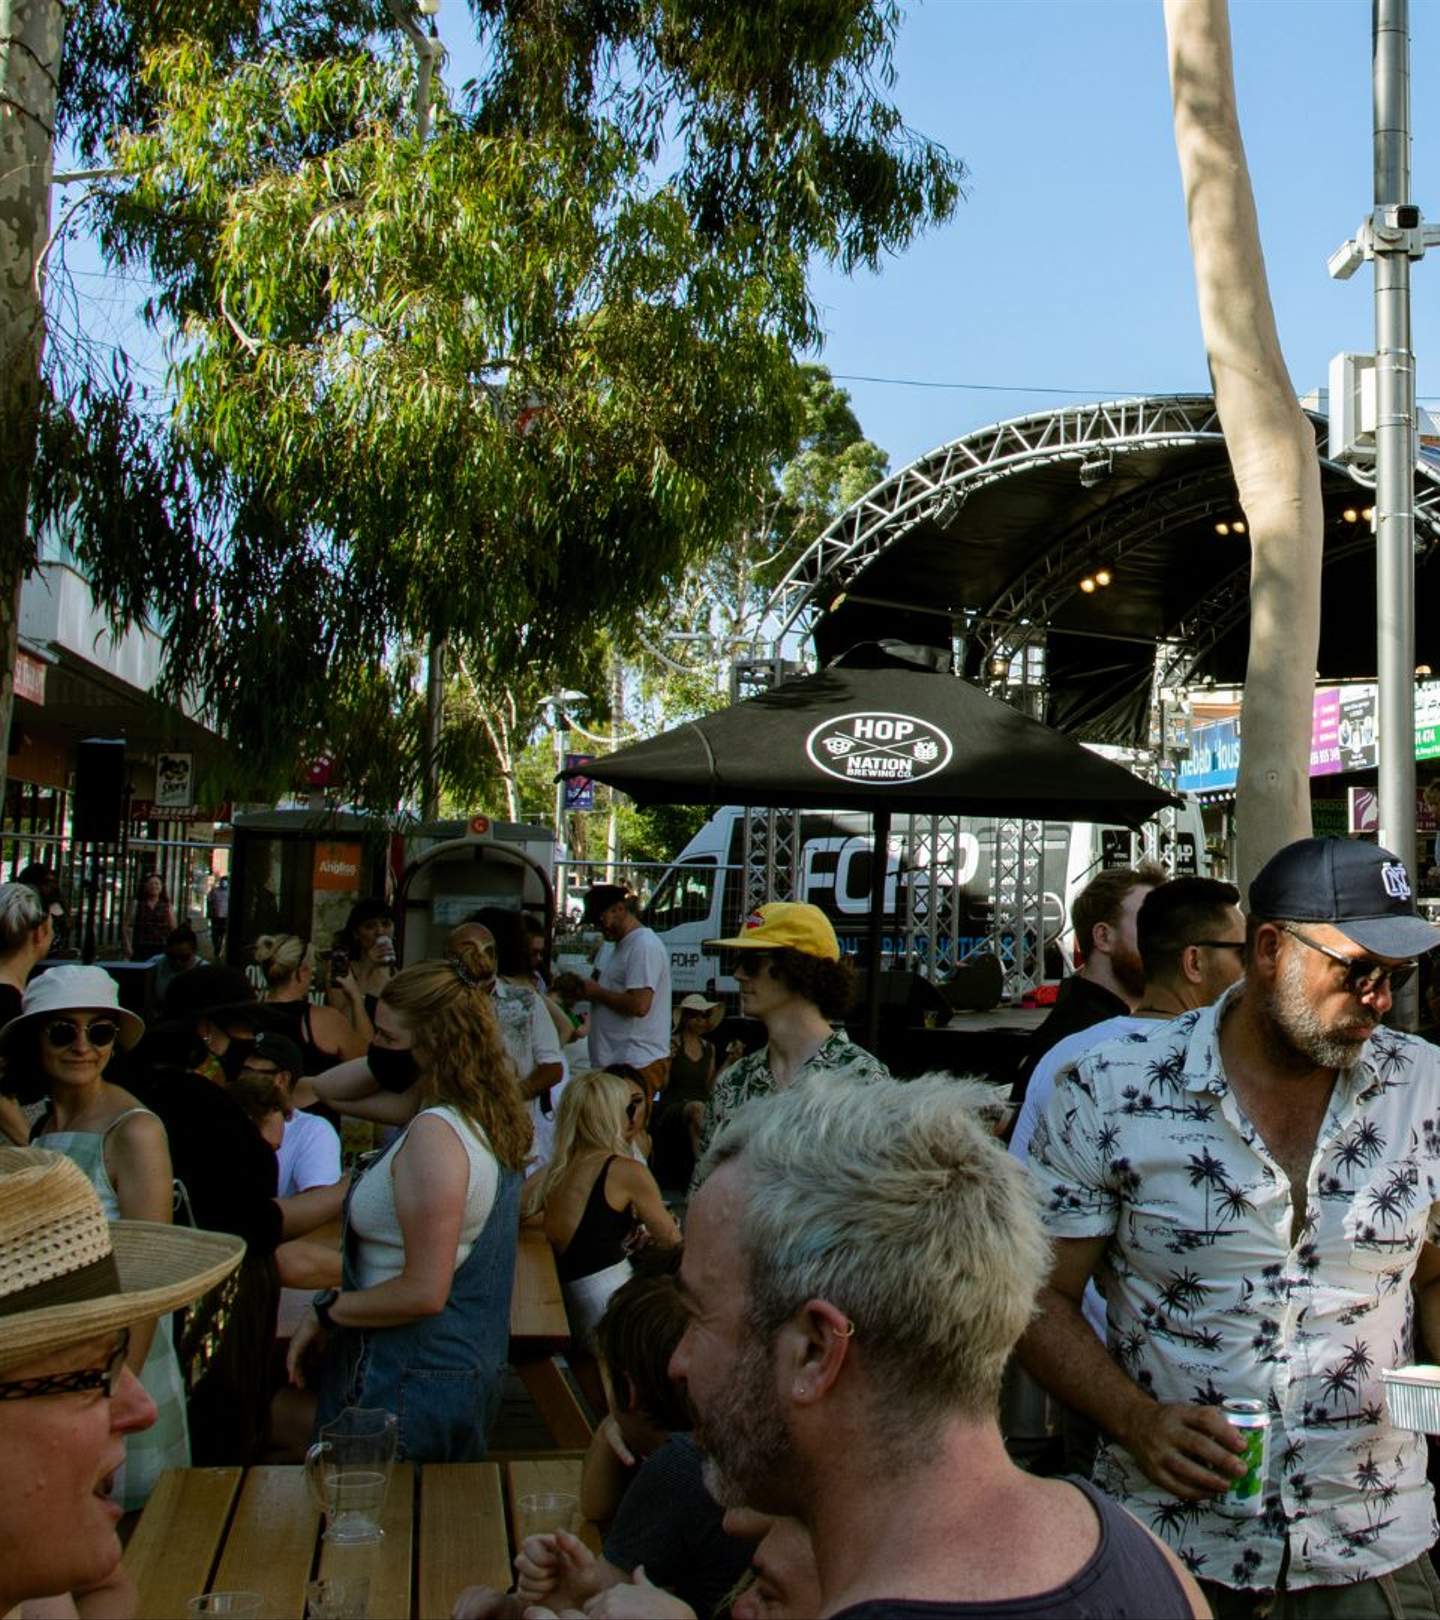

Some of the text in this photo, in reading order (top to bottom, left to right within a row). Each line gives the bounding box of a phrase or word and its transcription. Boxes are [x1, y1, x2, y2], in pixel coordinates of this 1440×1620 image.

[854, 719, 914, 740] HOP
[847, 756, 912, 770] NATION
[846, 769, 895, 778] BREWING
